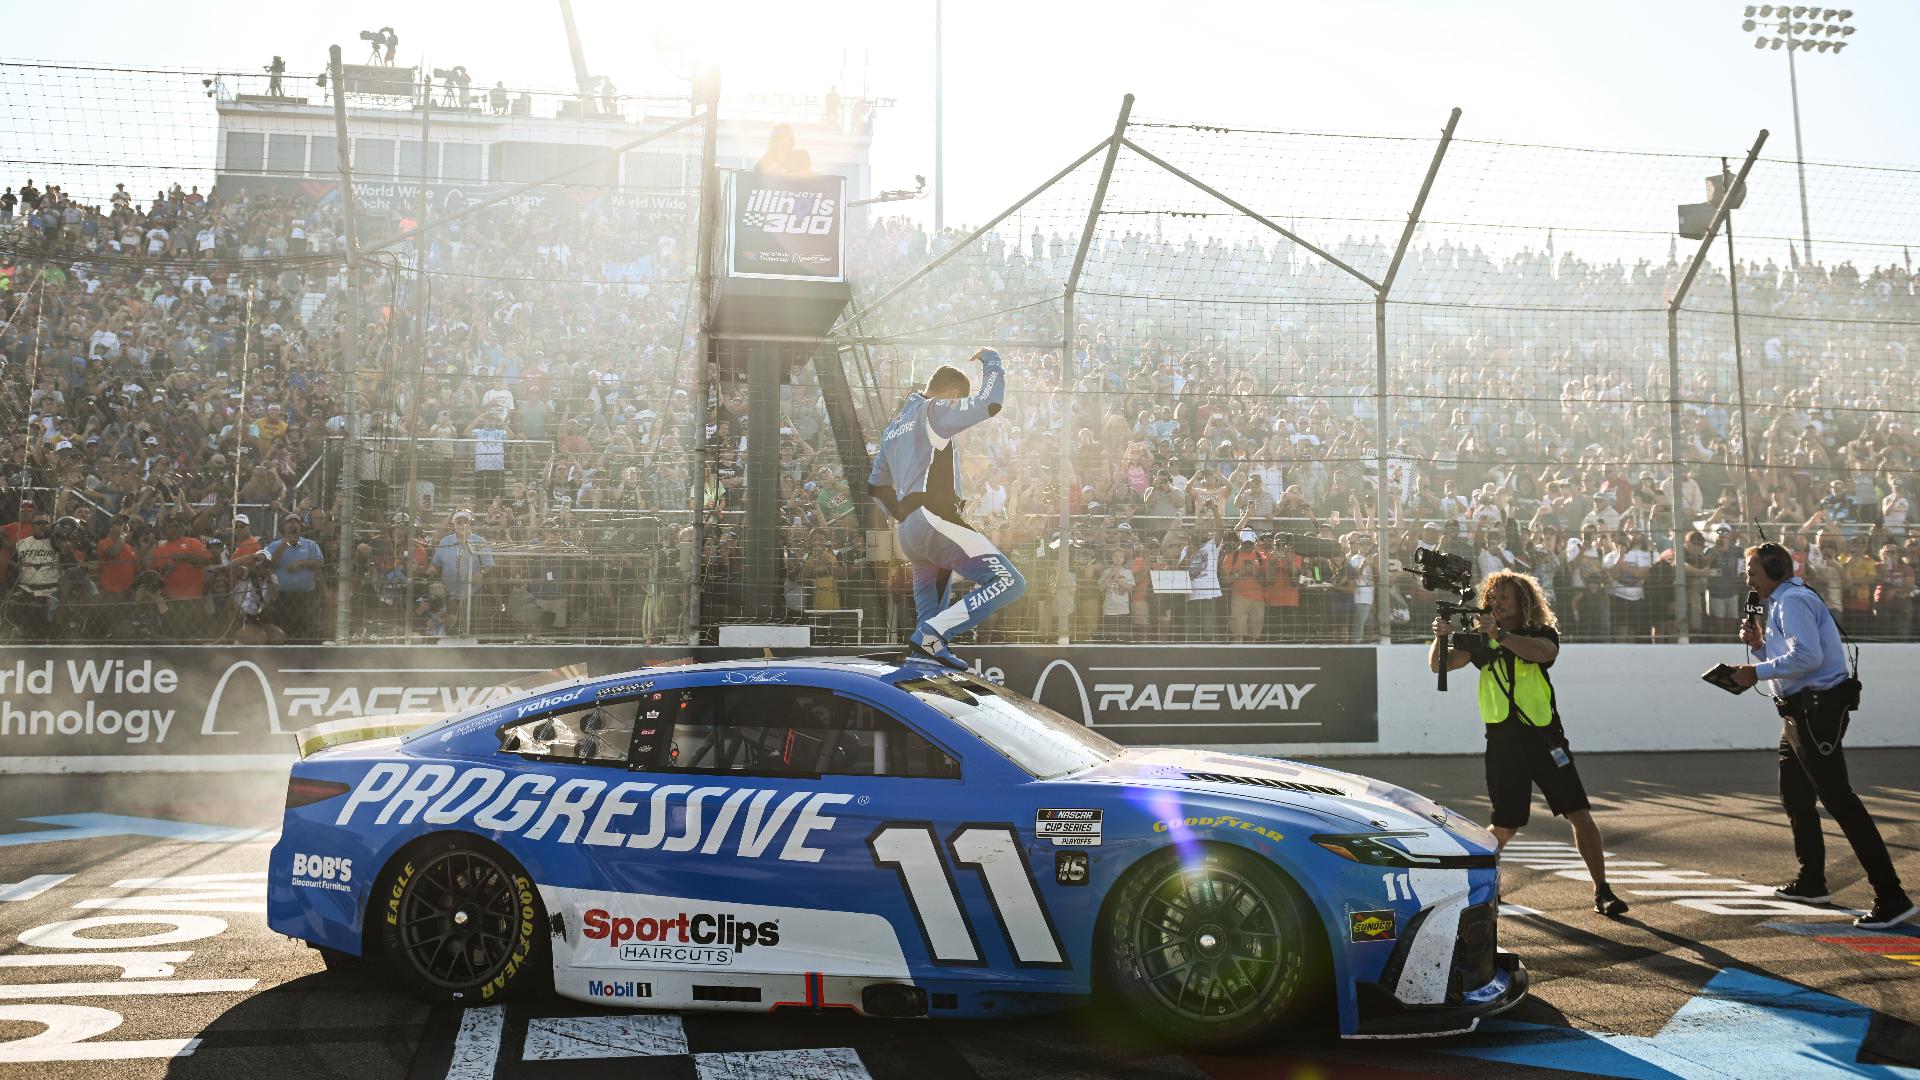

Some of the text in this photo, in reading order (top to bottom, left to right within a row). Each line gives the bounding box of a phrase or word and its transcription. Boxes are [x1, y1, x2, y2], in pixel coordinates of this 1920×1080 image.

[398, 185, 434, 199] Wie
[0, 659, 179, 695] rld Wide
[283, 686, 521, 717] RACEWA
[517, 687, 586, 718] yahoo!
[1094, 683, 1316, 711] RACEWAY
[1, 700, 176, 744] hnology
[334, 762, 855, 863] PROGRESSIVE
[1044, 822, 1093, 832] CUP SERIES
[1057, 810, 1093, 820] NASCAR
[1061, 837, 1092, 845] PLAYOFFS
[1153, 815, 1284, 843] GOODYEAR
[292, 852, 353, 882] BOB'S
[1057, 855, 1087, 882] 16
[291, 877, 351, 892] Discount Furniture
[386, 861, 416, 926] EAGLE
[868, 825, 1068, 967] 11
[1382, 872, 1412, 902] 11
[482, 876, 535, 999] GOODYEAR
[582, 908, 780, 953] SportClips
[1354, 920, 1393, 932] SUNOCO
[624, 946, 729, 963] HAIRCUTS
[588, 980, 634, 998] Mobil
